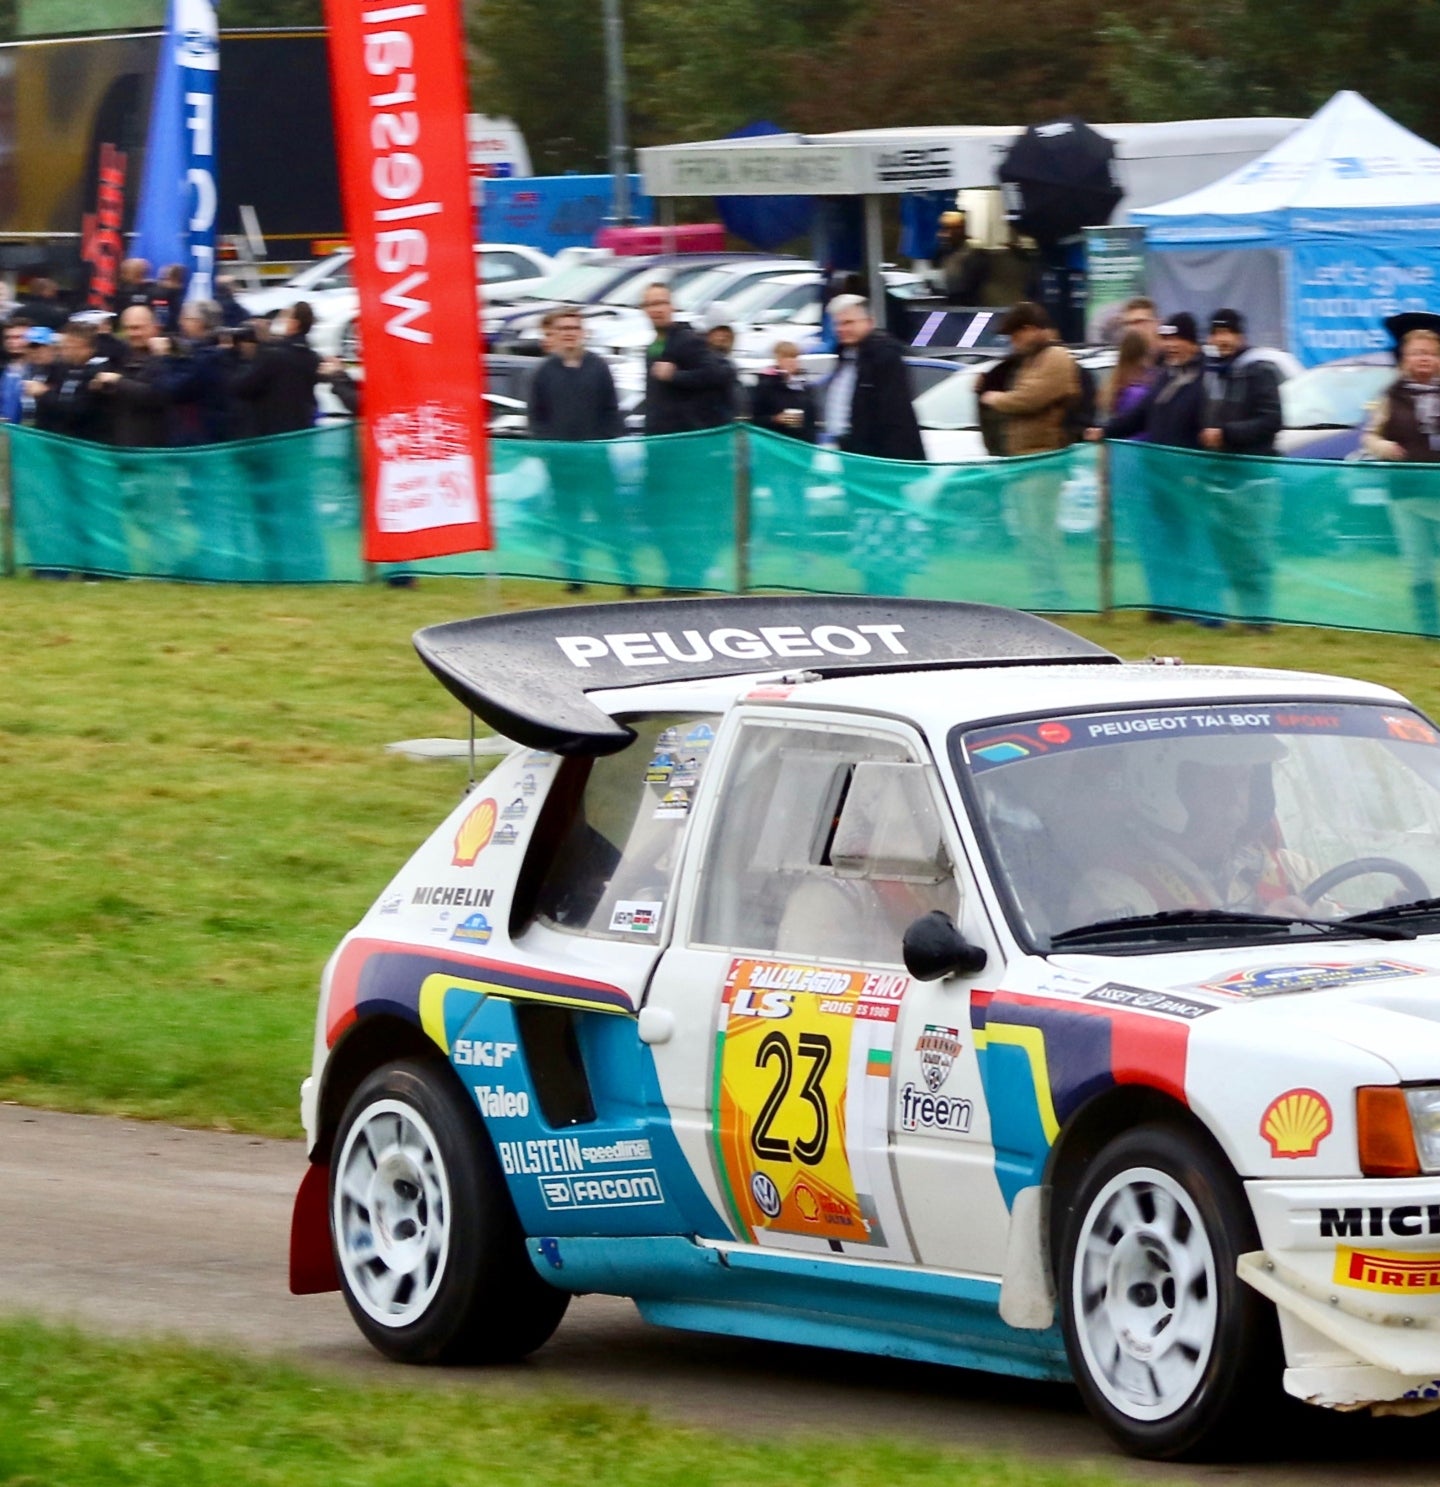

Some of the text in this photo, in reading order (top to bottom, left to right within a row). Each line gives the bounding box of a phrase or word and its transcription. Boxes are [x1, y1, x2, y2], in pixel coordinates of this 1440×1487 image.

[555, 624, 909, 668] PEUGEOT
[1087, 715, 1188, 738] PEUGEOT
[1191, 713, 1271, 728] TALBOT
[411, 886, 495, 908] MICHELIN
[819, 999, 854, 1015] 2016
[453, 1039, 518, 1068] SKF
[474, 1084, 529, 1118] Valeo
[751, 1030, 832, 1166] 23
[902, 1085, 972, 1130] freem
[499, 1138, 652, 1175] BILSTEIN speedline
[573, 1177, 658, 1201] FACOM
